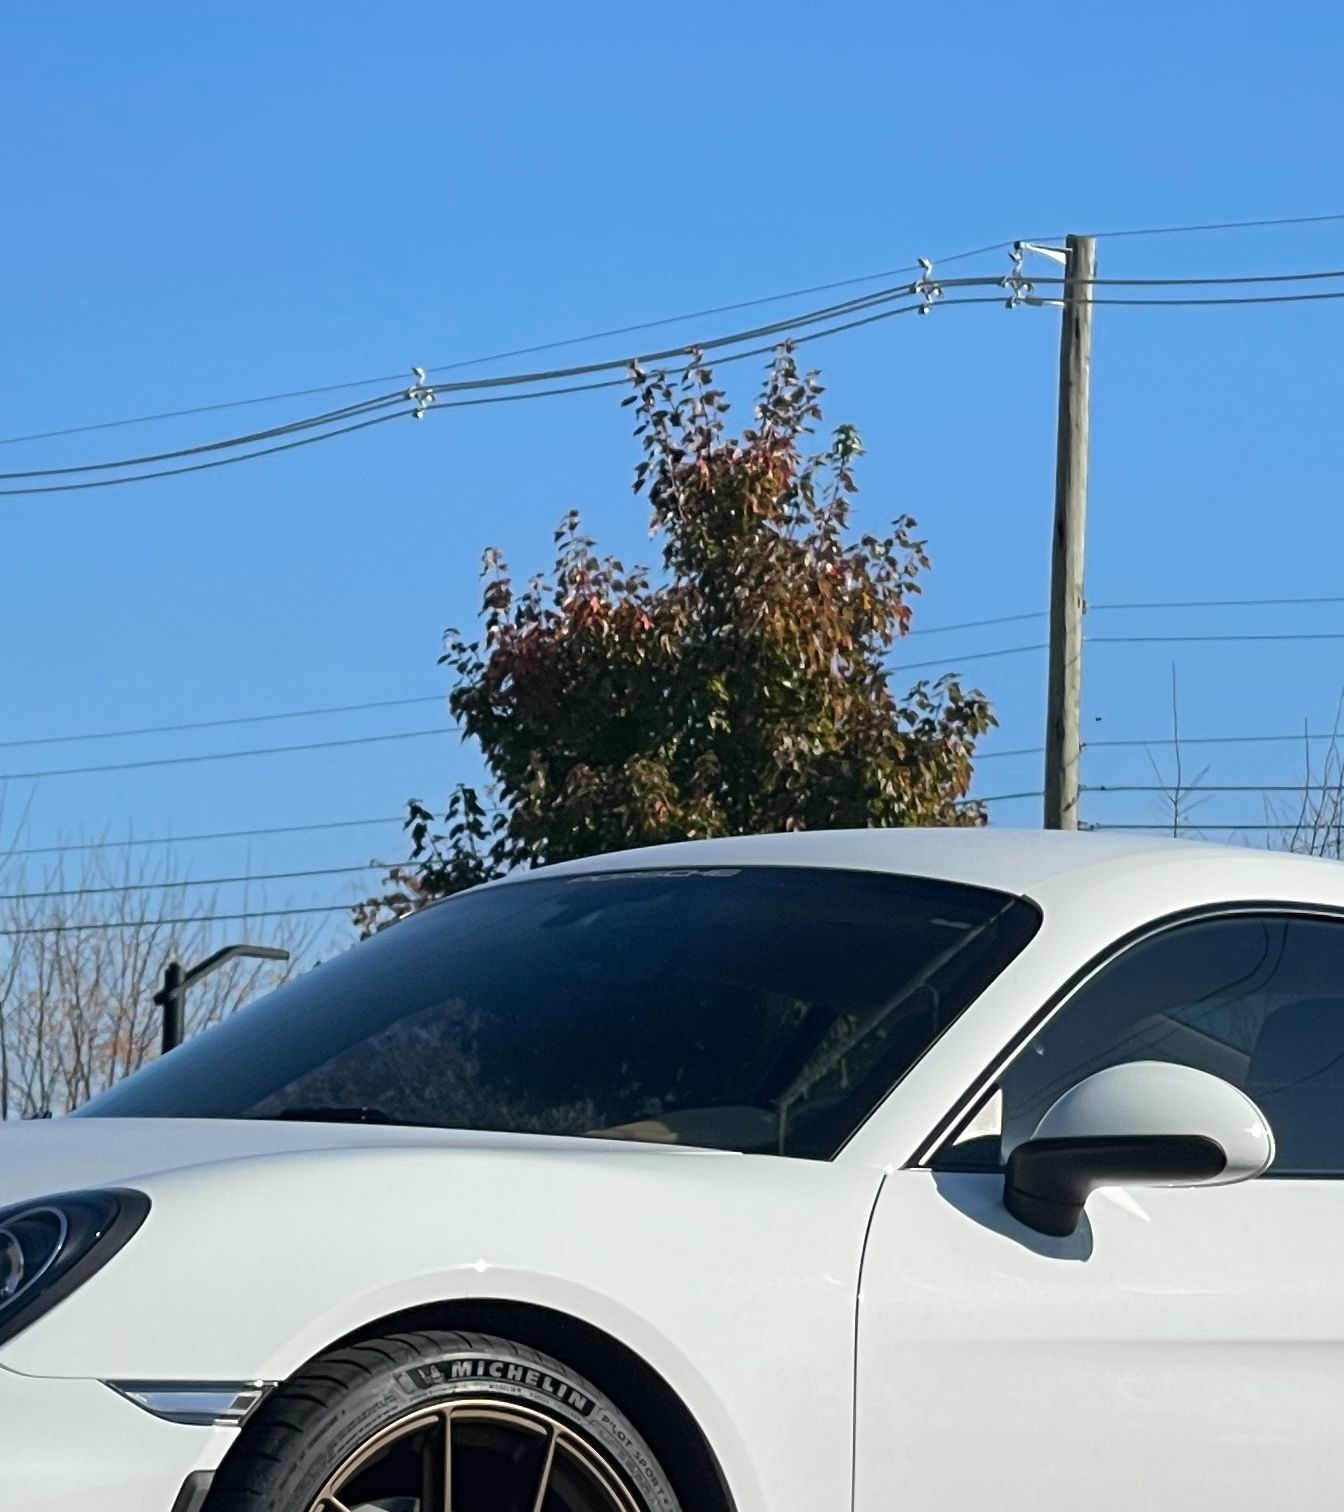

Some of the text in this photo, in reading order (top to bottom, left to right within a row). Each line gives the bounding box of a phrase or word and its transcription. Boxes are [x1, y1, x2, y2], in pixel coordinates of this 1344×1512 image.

[451, 1360, 588, 1410] MICHELIN
[601, 1415, 632, 1447] PILOT
[634, 1451, 665, 1495] SPORT
